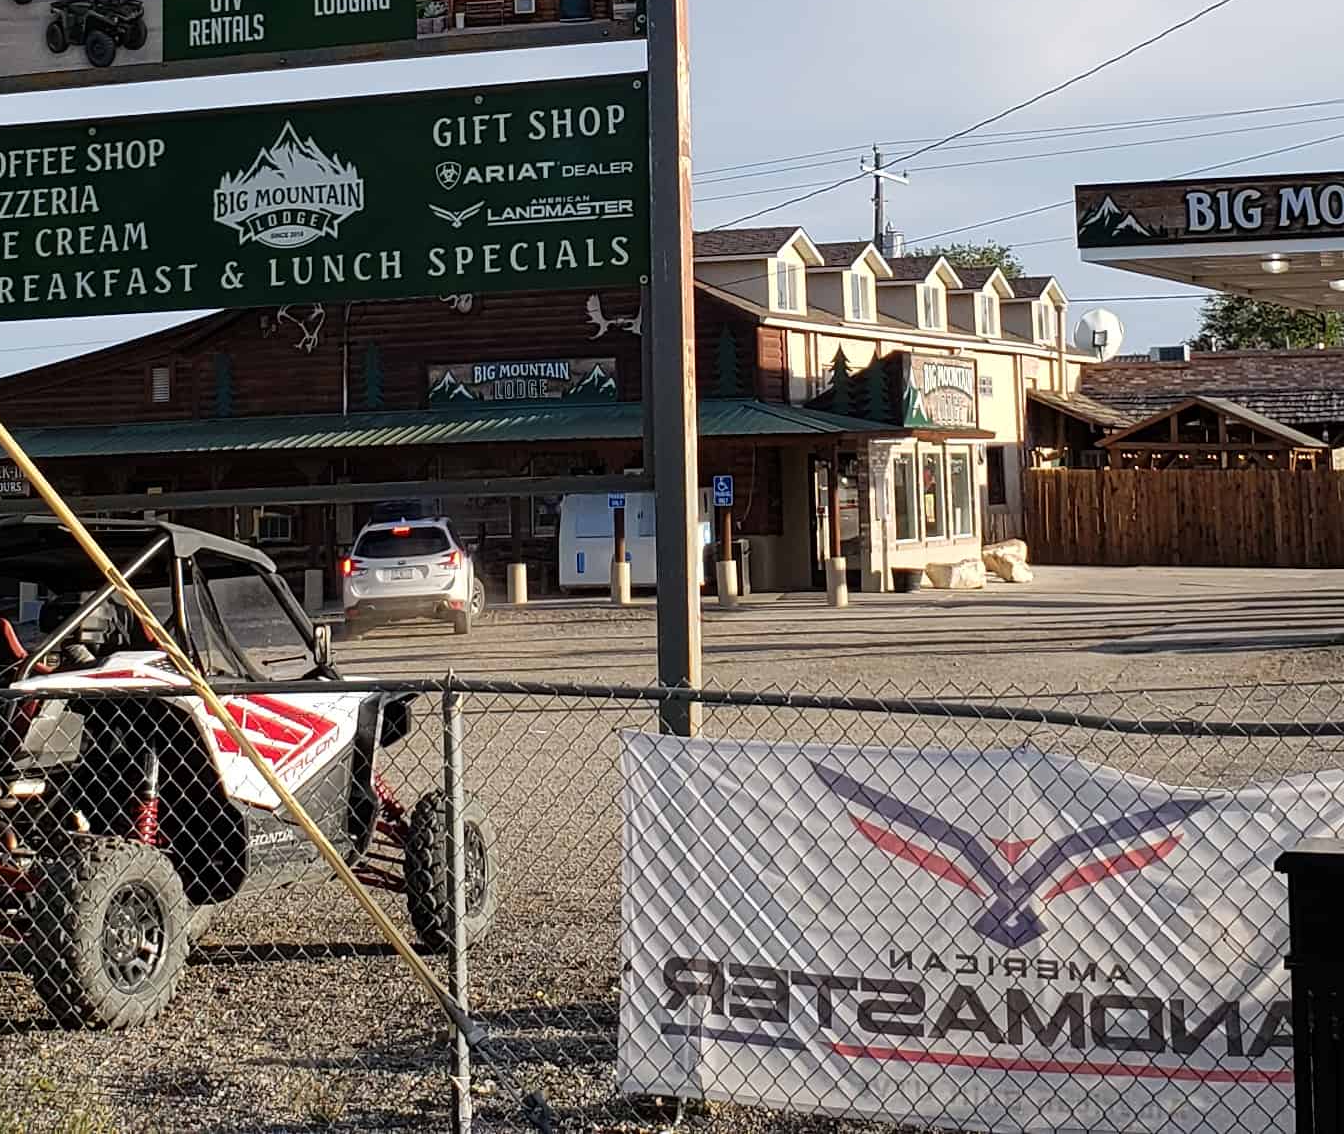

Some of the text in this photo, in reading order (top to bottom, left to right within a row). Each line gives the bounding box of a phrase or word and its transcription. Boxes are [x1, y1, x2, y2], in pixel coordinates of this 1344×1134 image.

[189, 14, 264, 47] RENTALS
[433, 104, 625, 147] GIFT SHOP
[85, 138, 165, 172] SHOP
[463, 161, 634, 185] ARIAT DEALER
[217, 183, 361, 215] BIG MOUNTAIN
[488, 200, 634, 221] LANDMASTER
[530, 194, 591, 205] AMERICAN
[1185, 189, 1263, 232] BIG
[256, 210, 321, 231] LODGE
[34, 221, 149, 258] CREAM
[221, 261, 245, 290] &
[268, 250, 403, 287] LUNCH
[427, 236, 630, 277] SPECIALS
[474, 362, 570, 383] BIG MOUNTAIN
[495, 379, 549, 400] LODGE
[250, 829, 294, 846] HONDA
